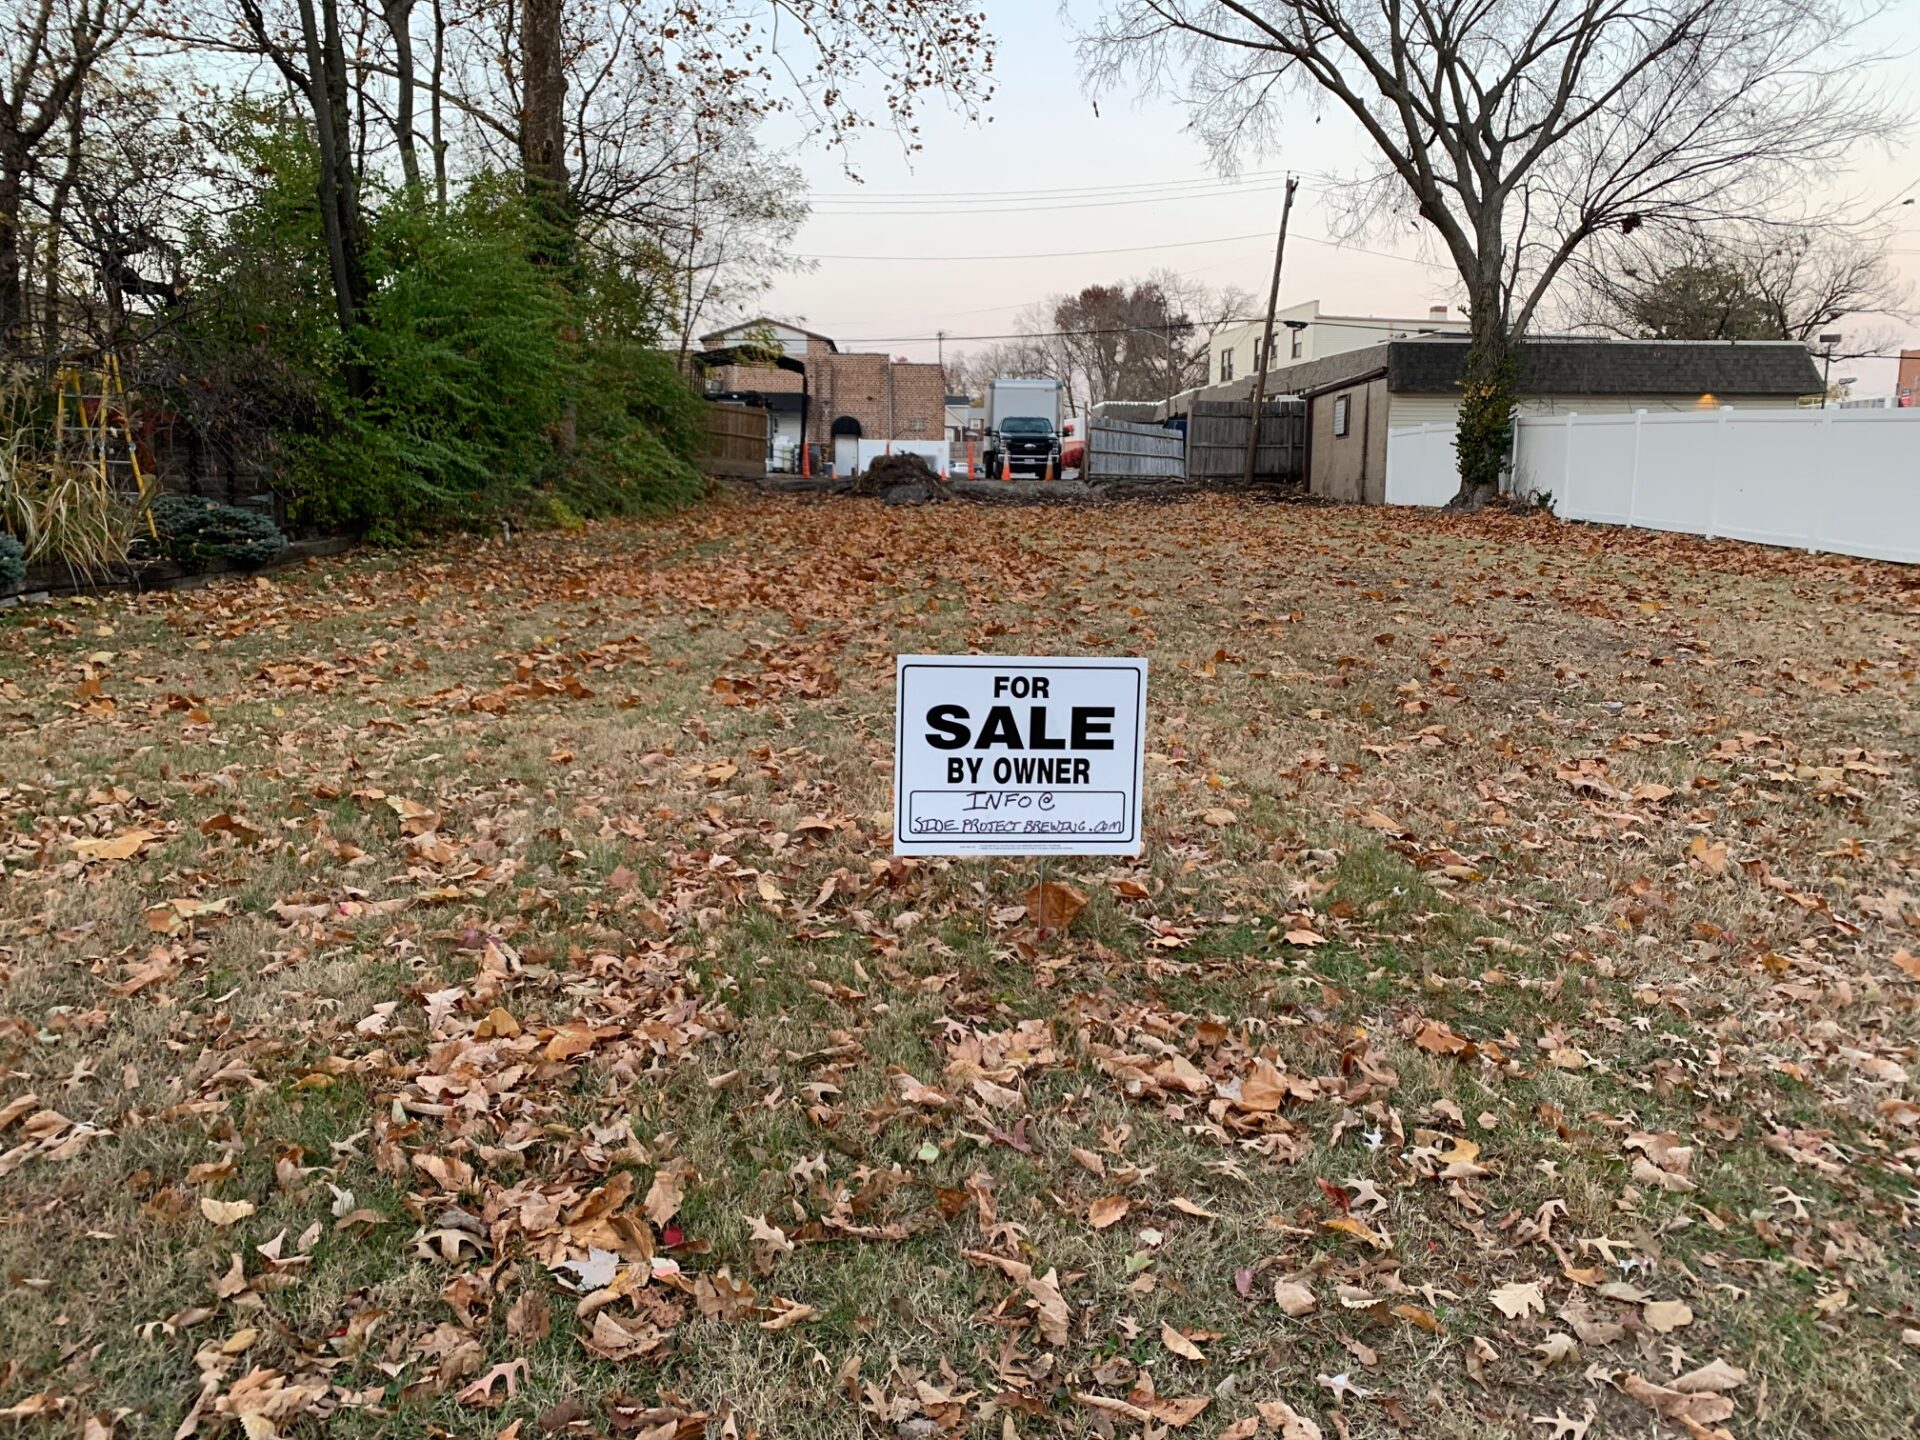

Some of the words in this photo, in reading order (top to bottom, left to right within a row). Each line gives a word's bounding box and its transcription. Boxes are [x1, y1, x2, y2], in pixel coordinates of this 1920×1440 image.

[994, 676, 1050, 698] FOR
[925, 704, 1116, 750] SALE
[947, 757, 983, 784] BY
[993, 757, 1091, 784] OWNER
